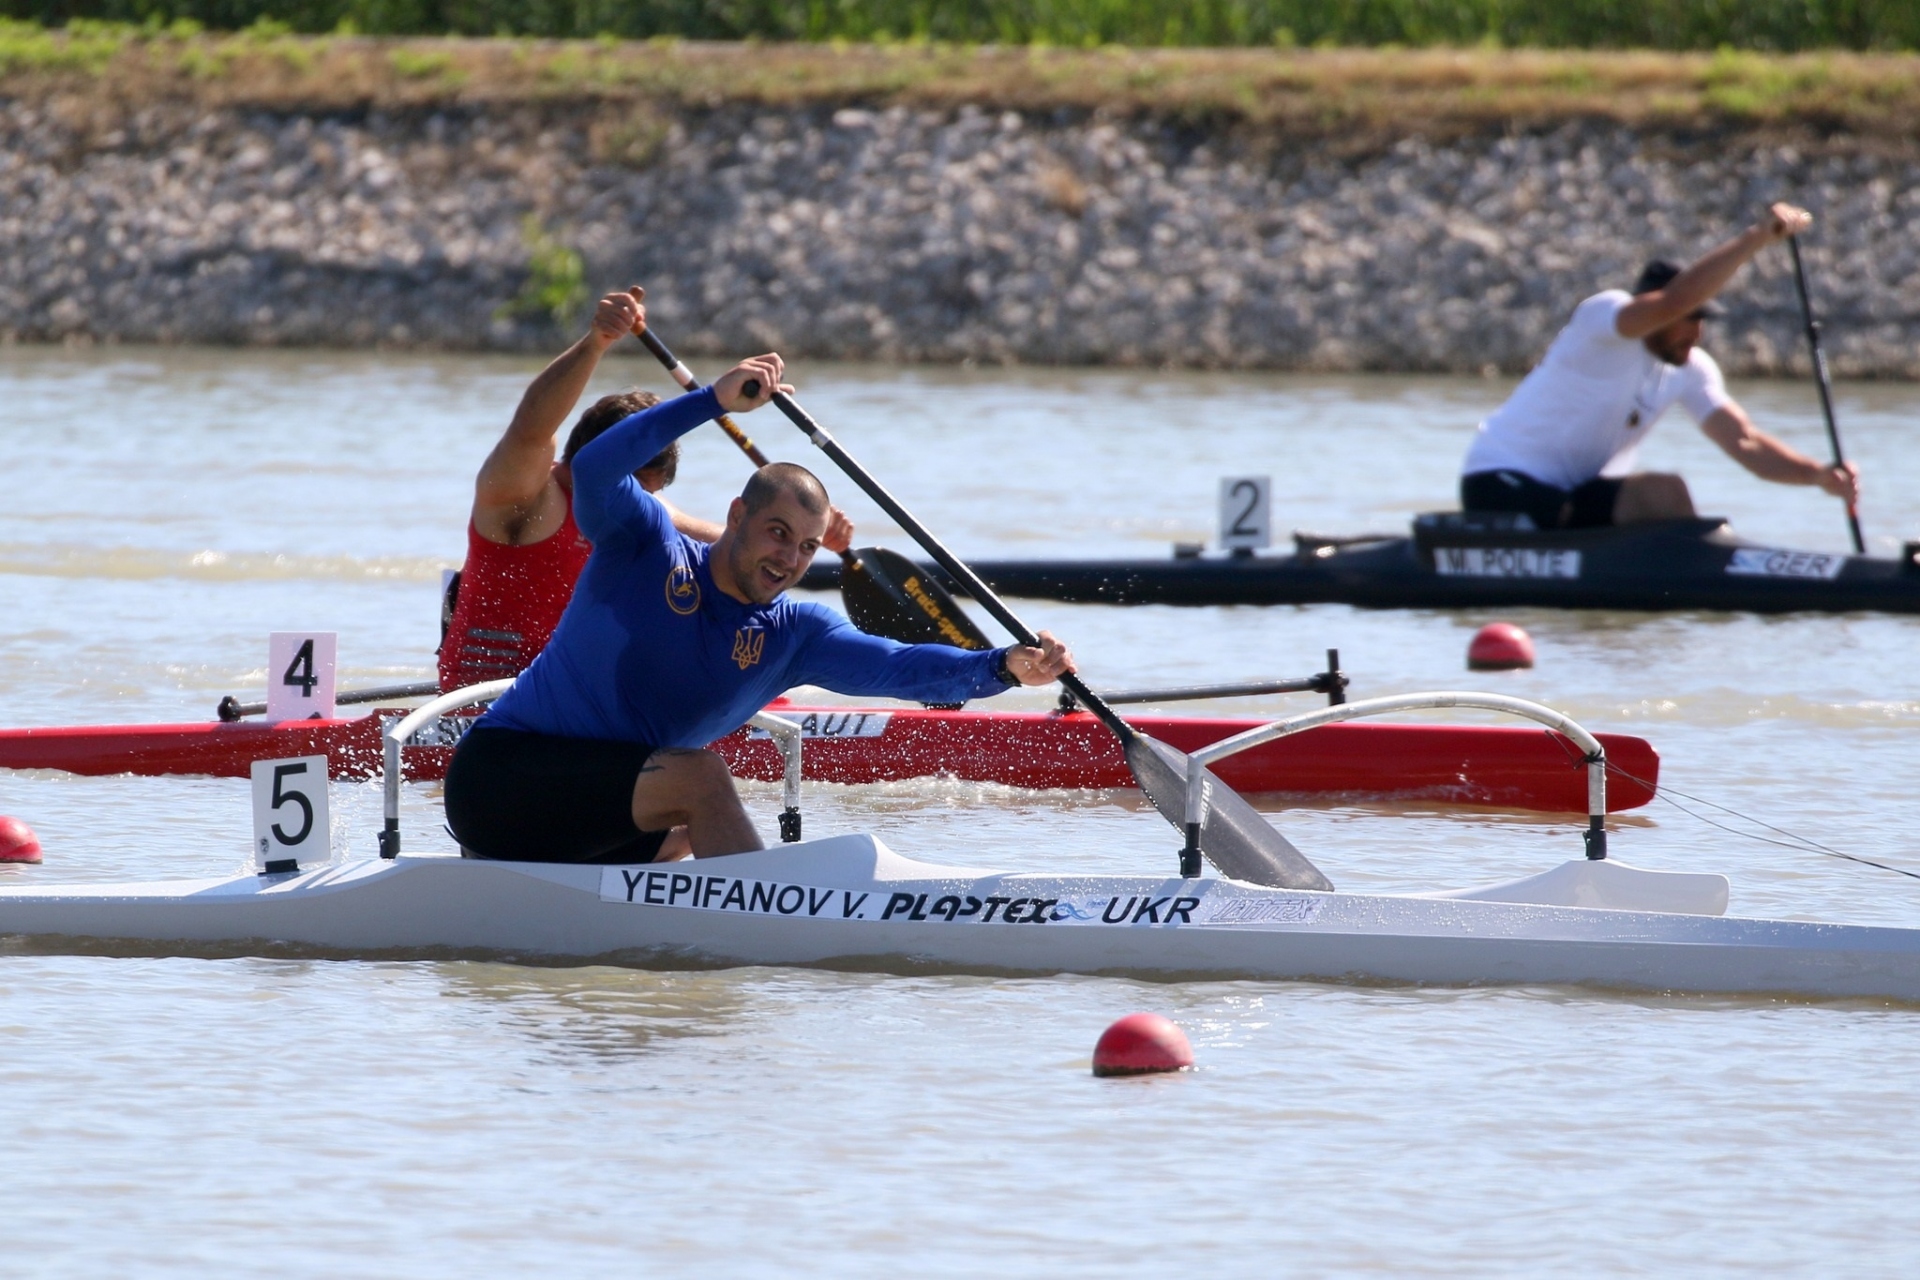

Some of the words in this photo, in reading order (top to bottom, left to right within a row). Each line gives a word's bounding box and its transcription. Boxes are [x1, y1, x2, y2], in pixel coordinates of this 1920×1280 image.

[1230, 480, 1259, 536] 2
[1765, 550, 1832, 577] GER
[283, 639, 318, 697] 4
[801, 713, 876, 736] AUT
[271, 762, 314, 846] 5
[621, 869, 834, 916] YEPIFANOV
[843, 891, 869, 919] V.
[880, 893, 1058, 924] PLASTEX
[1102, 896, 1200, 924] UKR
